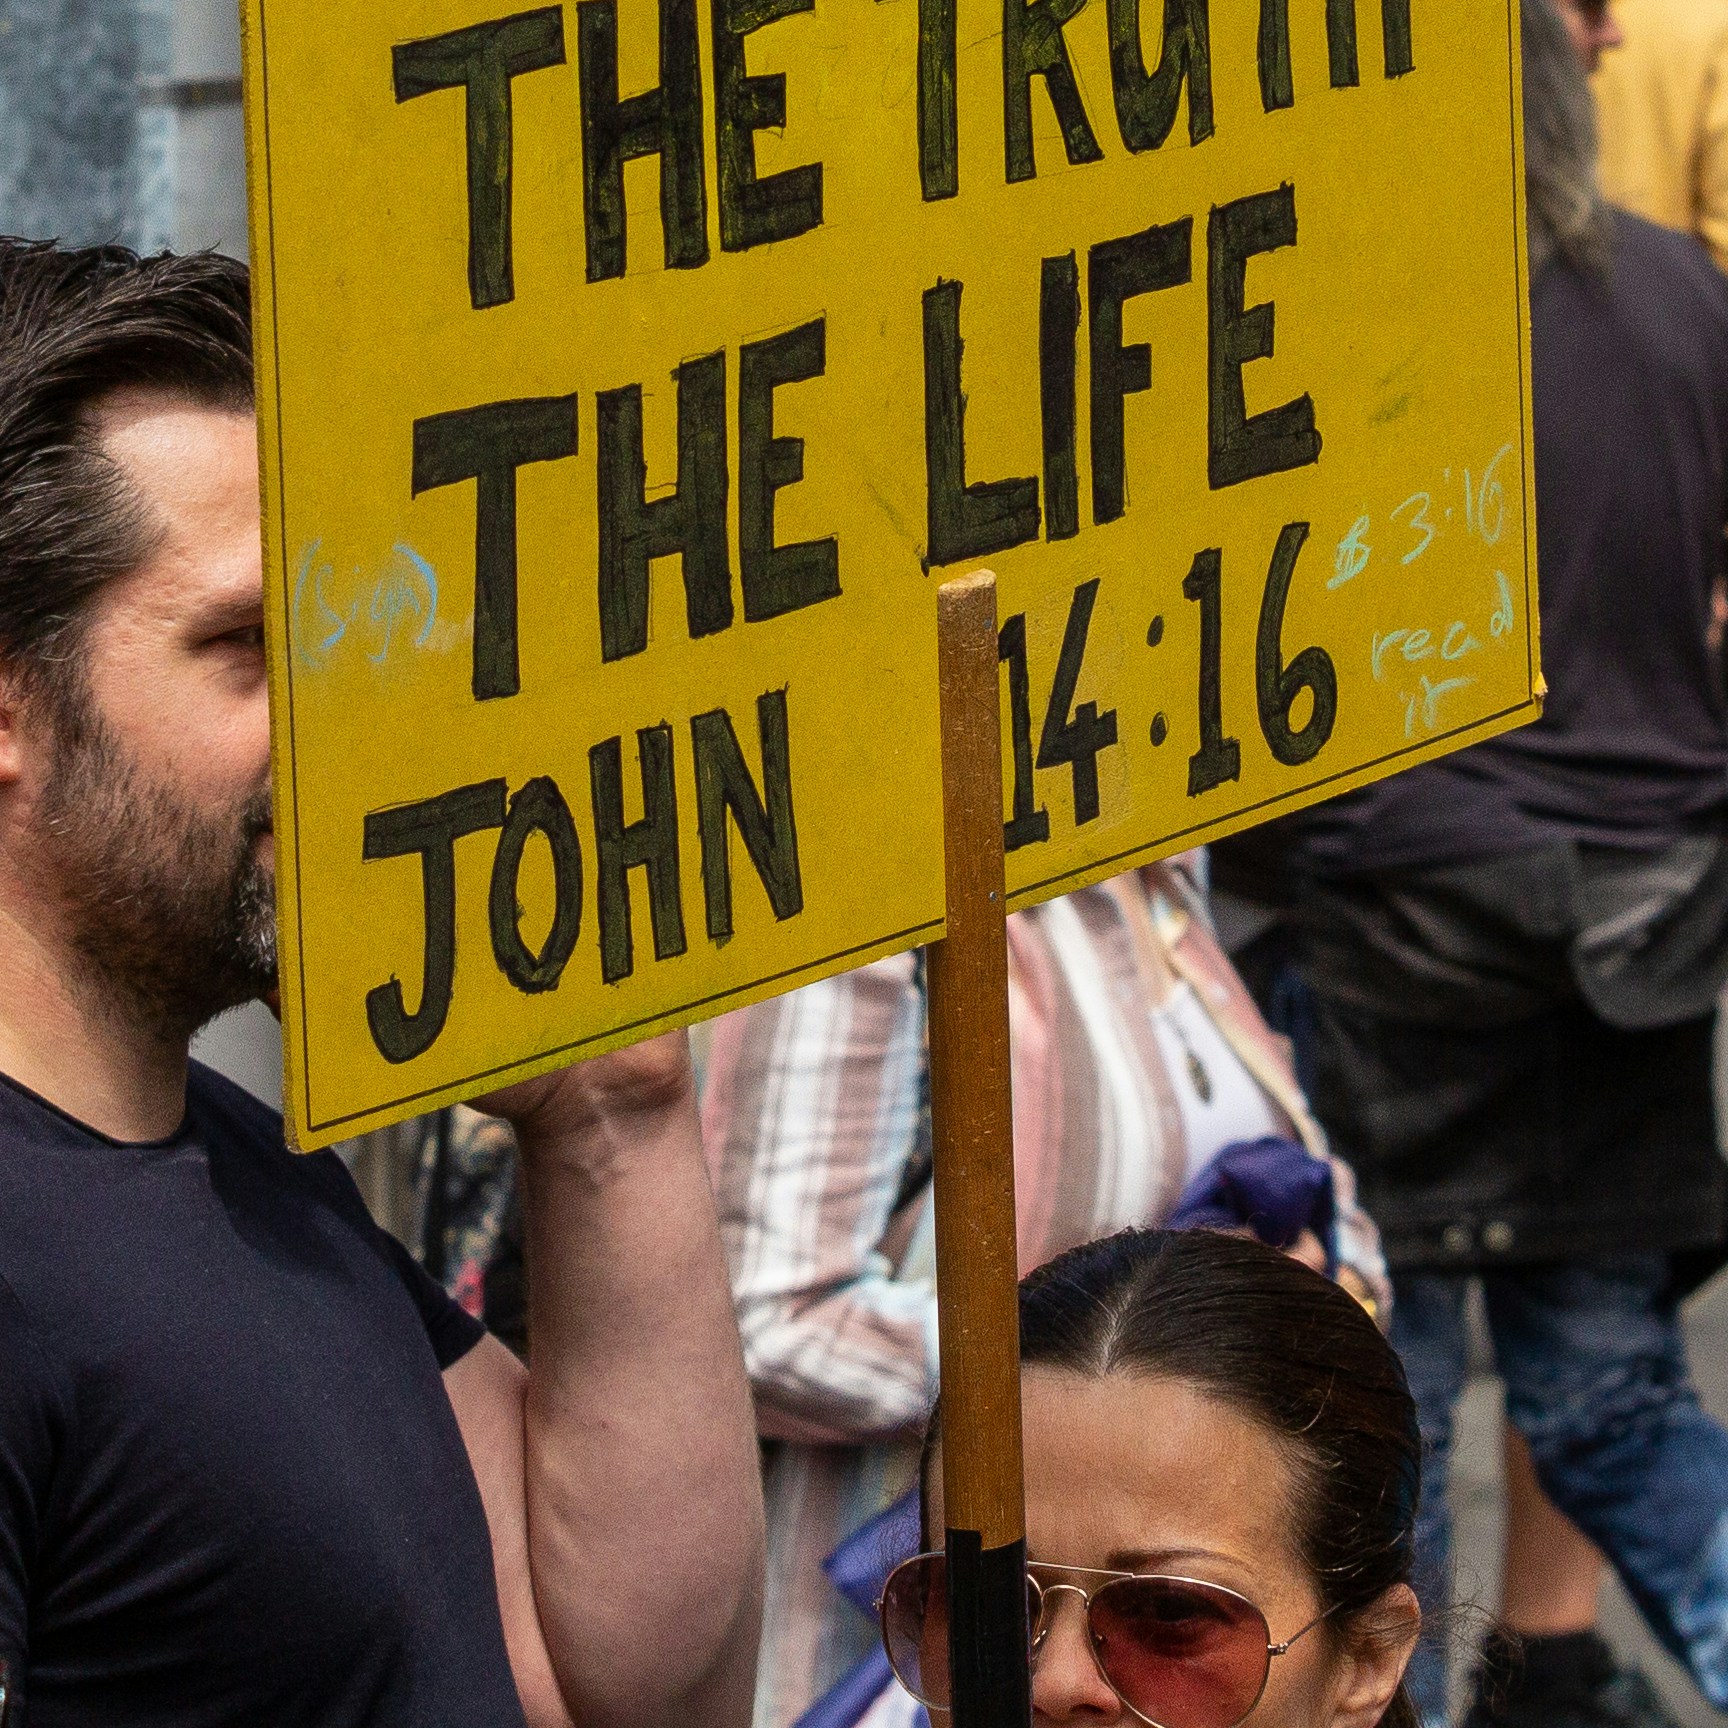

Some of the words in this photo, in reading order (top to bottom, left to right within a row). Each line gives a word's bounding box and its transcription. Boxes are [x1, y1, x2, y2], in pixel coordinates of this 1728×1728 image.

[411, 309, 843, 703] THE
[920, 180, 1323, 575] LIFE
[1388, 442, 1514, 566] 3:16
[362, 680, 804, 1065] JOHN
[997, 521, 1338, 854] 14:16
